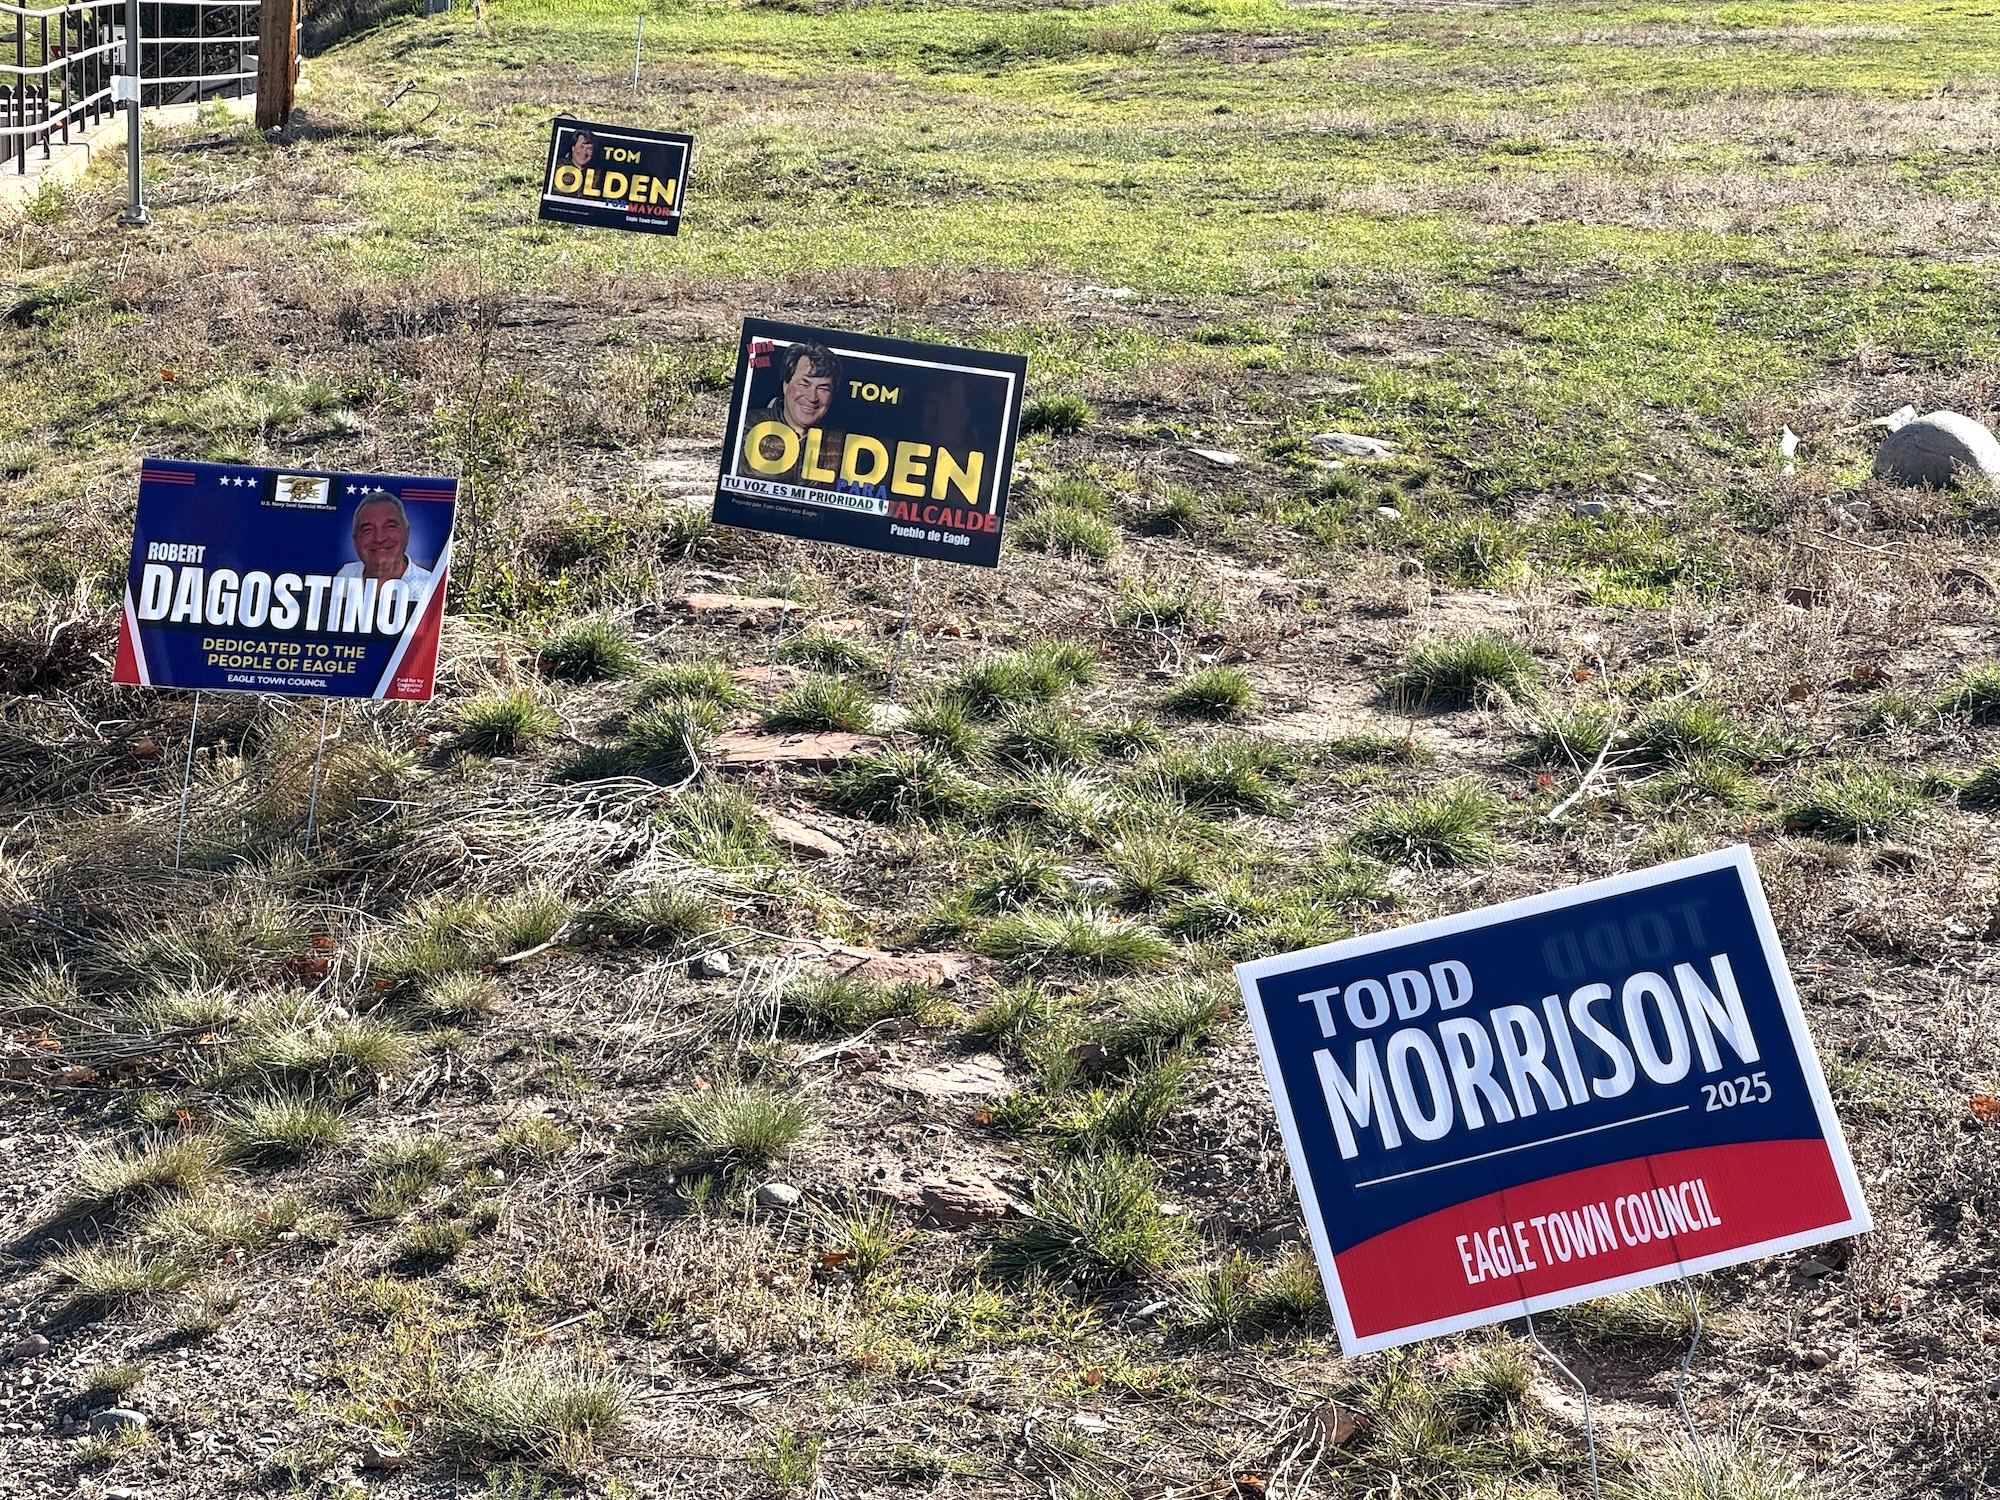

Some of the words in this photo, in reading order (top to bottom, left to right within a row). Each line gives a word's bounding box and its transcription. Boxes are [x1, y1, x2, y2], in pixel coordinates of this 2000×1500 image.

[604, 146, 641, 163] TOM
[554, 165, 676, 206] OLDEN
[605, 199, 627, 209] FOR
[628, 202, 671, 217] MAYOR
[849, 380, 900, 404] TOM
[744, 420, 984, 505] OLDEN
[723, 477, 741, 489] TU
[744, 481, 769, 494] VOZ,
[772, 485, 788, 496] ES
[791, 488, 805, 499] MI
[809, 492, 874, 510] PRIORIDAD
[836, 479, 888, 500] PARA
[762, 501, 774, 510] Tom
[775, 504, 792, 513] Olden
[802, 508, 818, 517] Eagle
[893, 500, 997, 533] ALCALDE
[890, 523, 926, 540] Pueblo
[927, 530, 941, 542] de
[942, 531, 971, 547] Eagle
[147, 541, 206, 564] ROBERT
[137, 563, 410, 636] DAGOSTINO
[202, 637, 301, 656] DEDICATED
[305, 644, 329, 657] TO
[333, 645, 366, 659] THE
[207, 653, 273, 670] PEOPLE
[275, 658, 300, 671] OF
[302, 660, 357, 674] EAGLE
[227, 674, 256, 684] EAGLE
[257, 675, 286, 686] TOWN
[287, 677, 328, 688] COUNCIL
[1298, 959, 1474, 1039] TODD
[1312, 952, 1760, 1161] MORRISON
[1700, 1071, 1773, 1113] 2025
[1455, 1221, 1537, 1285] EAGLE
[1530, 1201, 1619, 1266] TOWN
[1614, 1178, 1722, 1246] COUNCIL
